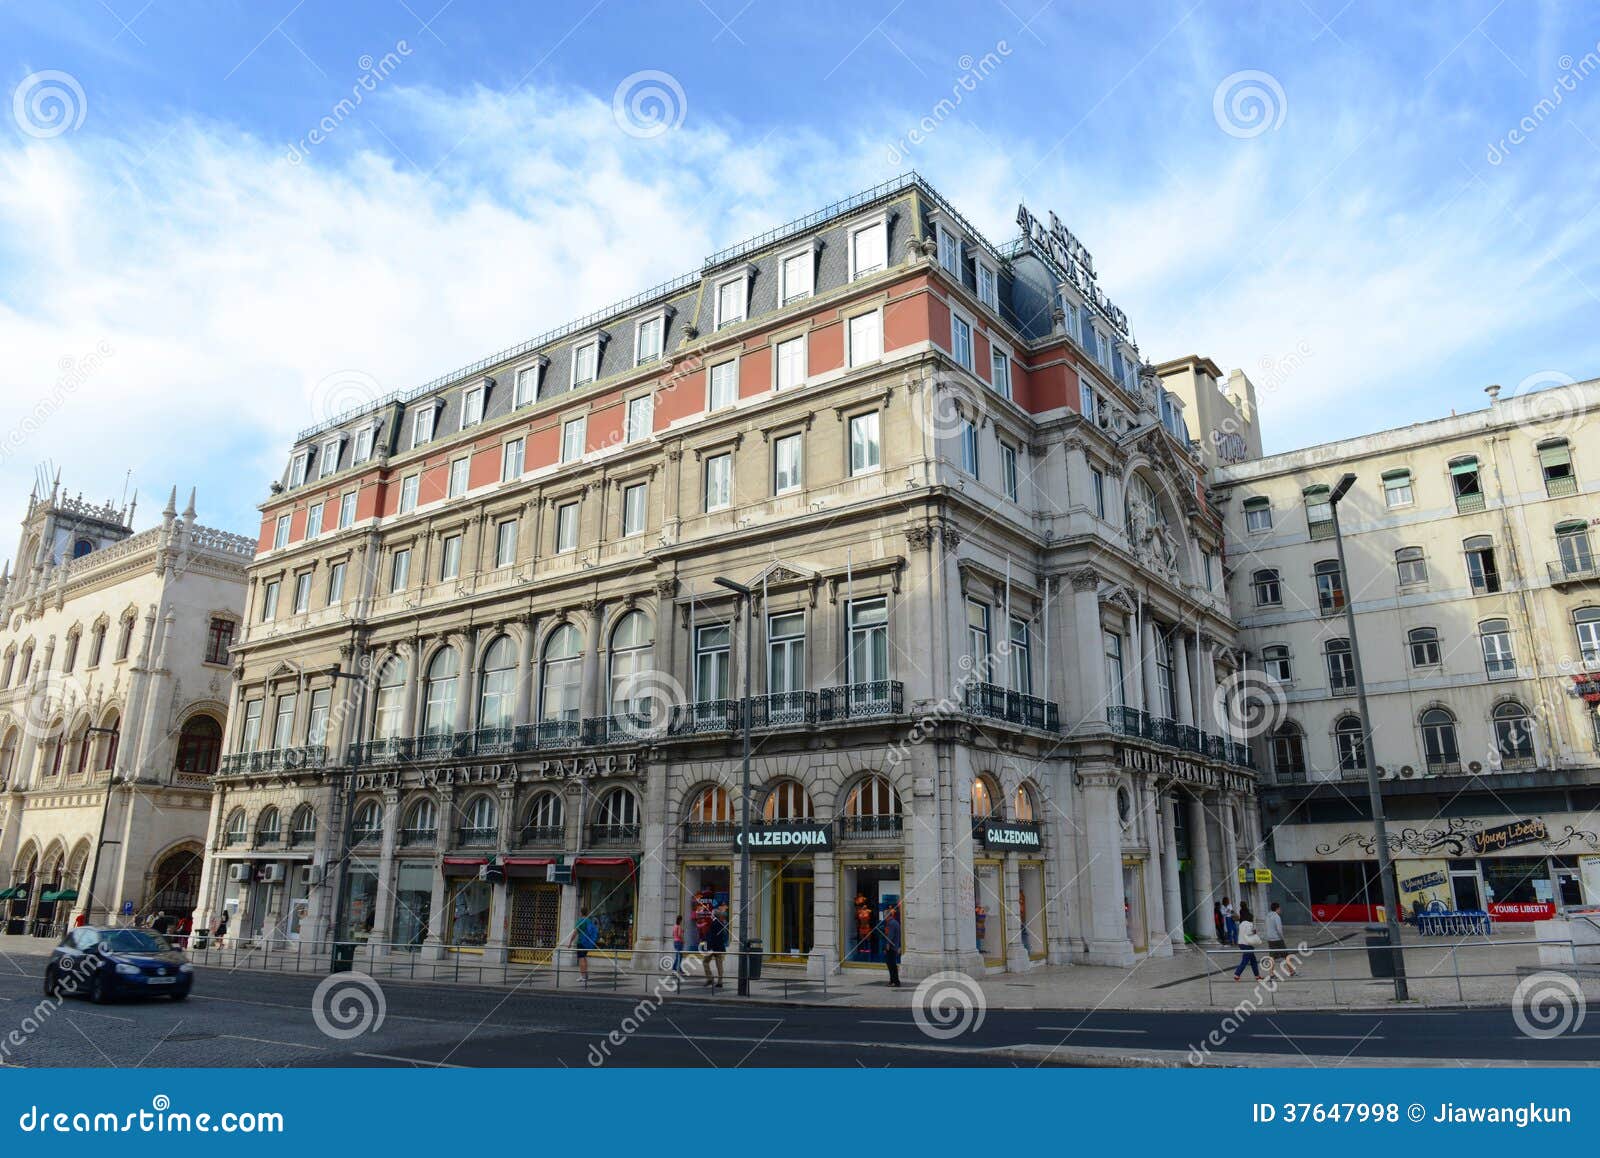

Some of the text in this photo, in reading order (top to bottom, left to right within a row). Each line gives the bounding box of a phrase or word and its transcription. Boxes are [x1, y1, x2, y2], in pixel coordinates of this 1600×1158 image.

[1048, 209, 1097, 280] HOTEL
[344, 753, 638, 790] HOTEL AVENIDA PALACE
[1123, 749, 1168, 773] HOTEL
[737, 830, 827, 846] CALZEDONIA
[987, 828, 1039, 845] CALZEDONIA
[1475, 829, 1506, 855] Young
[1494, 904, 1548, 913] YOUNG LIBERTY
